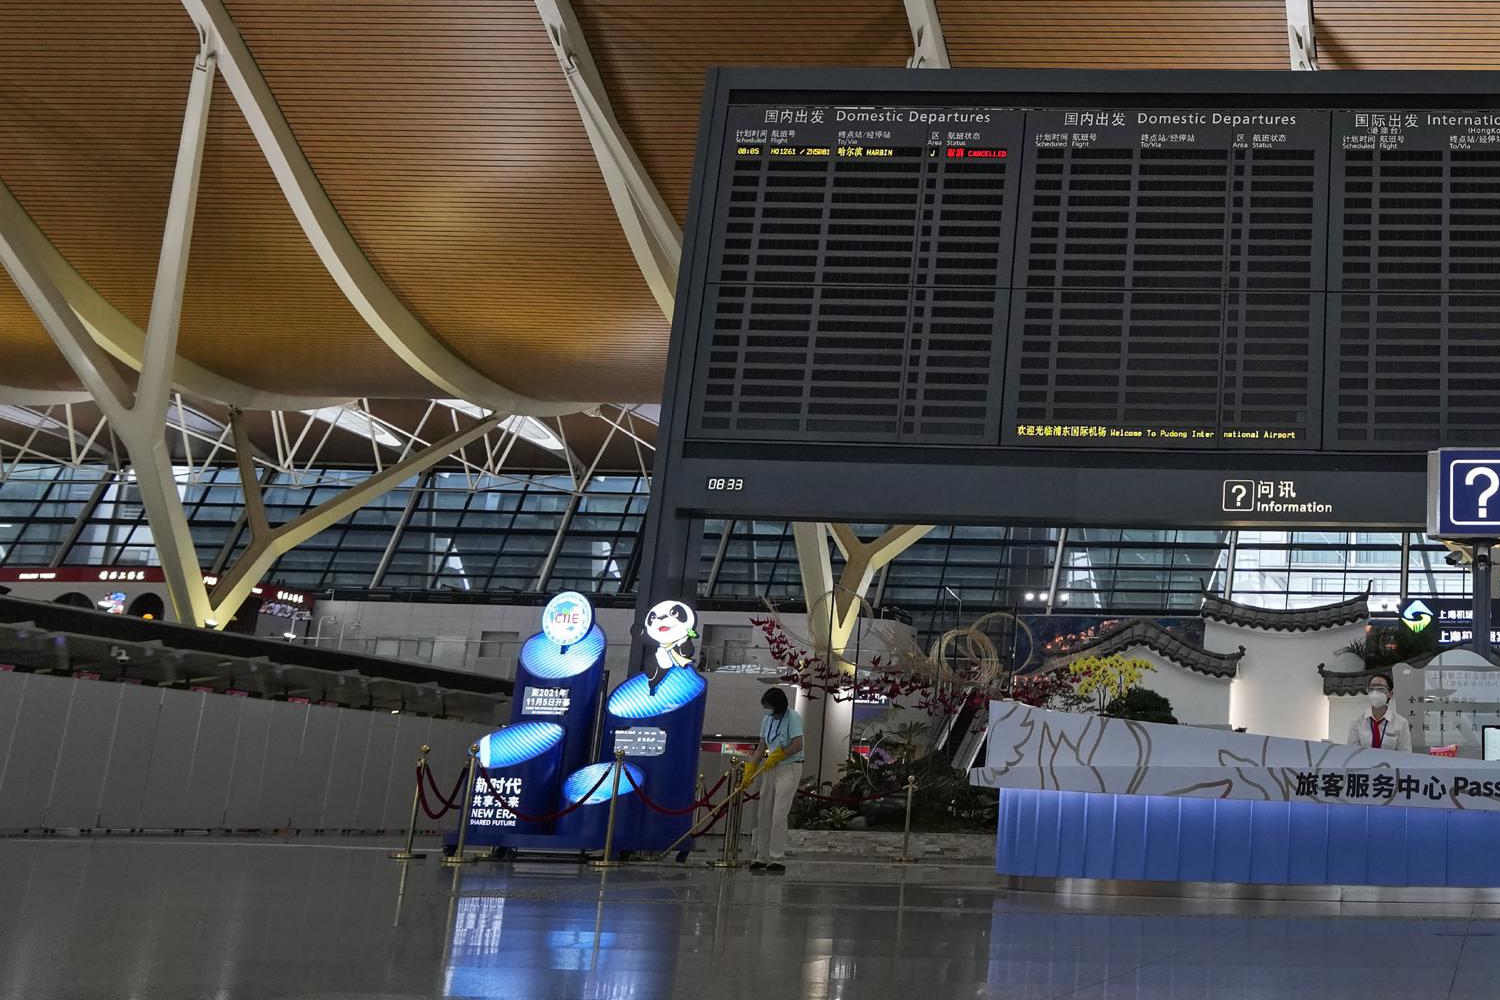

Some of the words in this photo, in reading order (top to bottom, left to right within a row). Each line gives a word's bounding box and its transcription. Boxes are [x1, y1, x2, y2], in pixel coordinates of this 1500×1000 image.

[765, 110, 823, 123] 国内出发
[836, 110, 903, 122] Domestic
[909, 111, 991, 125] Departures
[1065, 112, 1125, 126] 国内出发
[1137, 112, 1207, 125] Domestic
[1212, 113, 1297, 128] Departures
[1356, 114, 1418, 129] 国际出发
[736, 130, 767, 139] 计划时间
[771, 130, 795, 139] 航班号
[930, 132, 939, 141] 区
[1036, 133, 1068, 142] 计划时间
[1072, 133, 1096, 142] 航班号
[1237, 134, 1244, 142] 区
[1343, 135, 1375, 144] 计划时间
[1380, 135, 1404, 144] 航班号
[1072, 140, 1088, 148] Flight
[738, 147, 760, 155] 08:05
[771, 147, 796, 155] HO1261
[838, 146, 864, 157] 哈尔滨
[867, 148, 893, 157] HARBIN
[968, 150, 1007, 158] CANCELLED
[1017, 425, 1106, 436] 欢迎光临浦东国际机场
[1111, 428, 1143, 437] Welcome
[1147, 429, 1157, 437] To
[1161, 429, 1188, 440] Pudong
[1264, 431, 1296, 440] Airport
[1258, 481, 1296, 498] 问讯
[1257, 501, 1332, 512] Information
[475, 776, 522, 794] 新时代
[1295, 772, 1445, 801] 旅客服务中心
[470, 808, 494, 819] NEW
[495, 808, 517, 820] ERA
[491, 818, 517, 827] FUTURE
